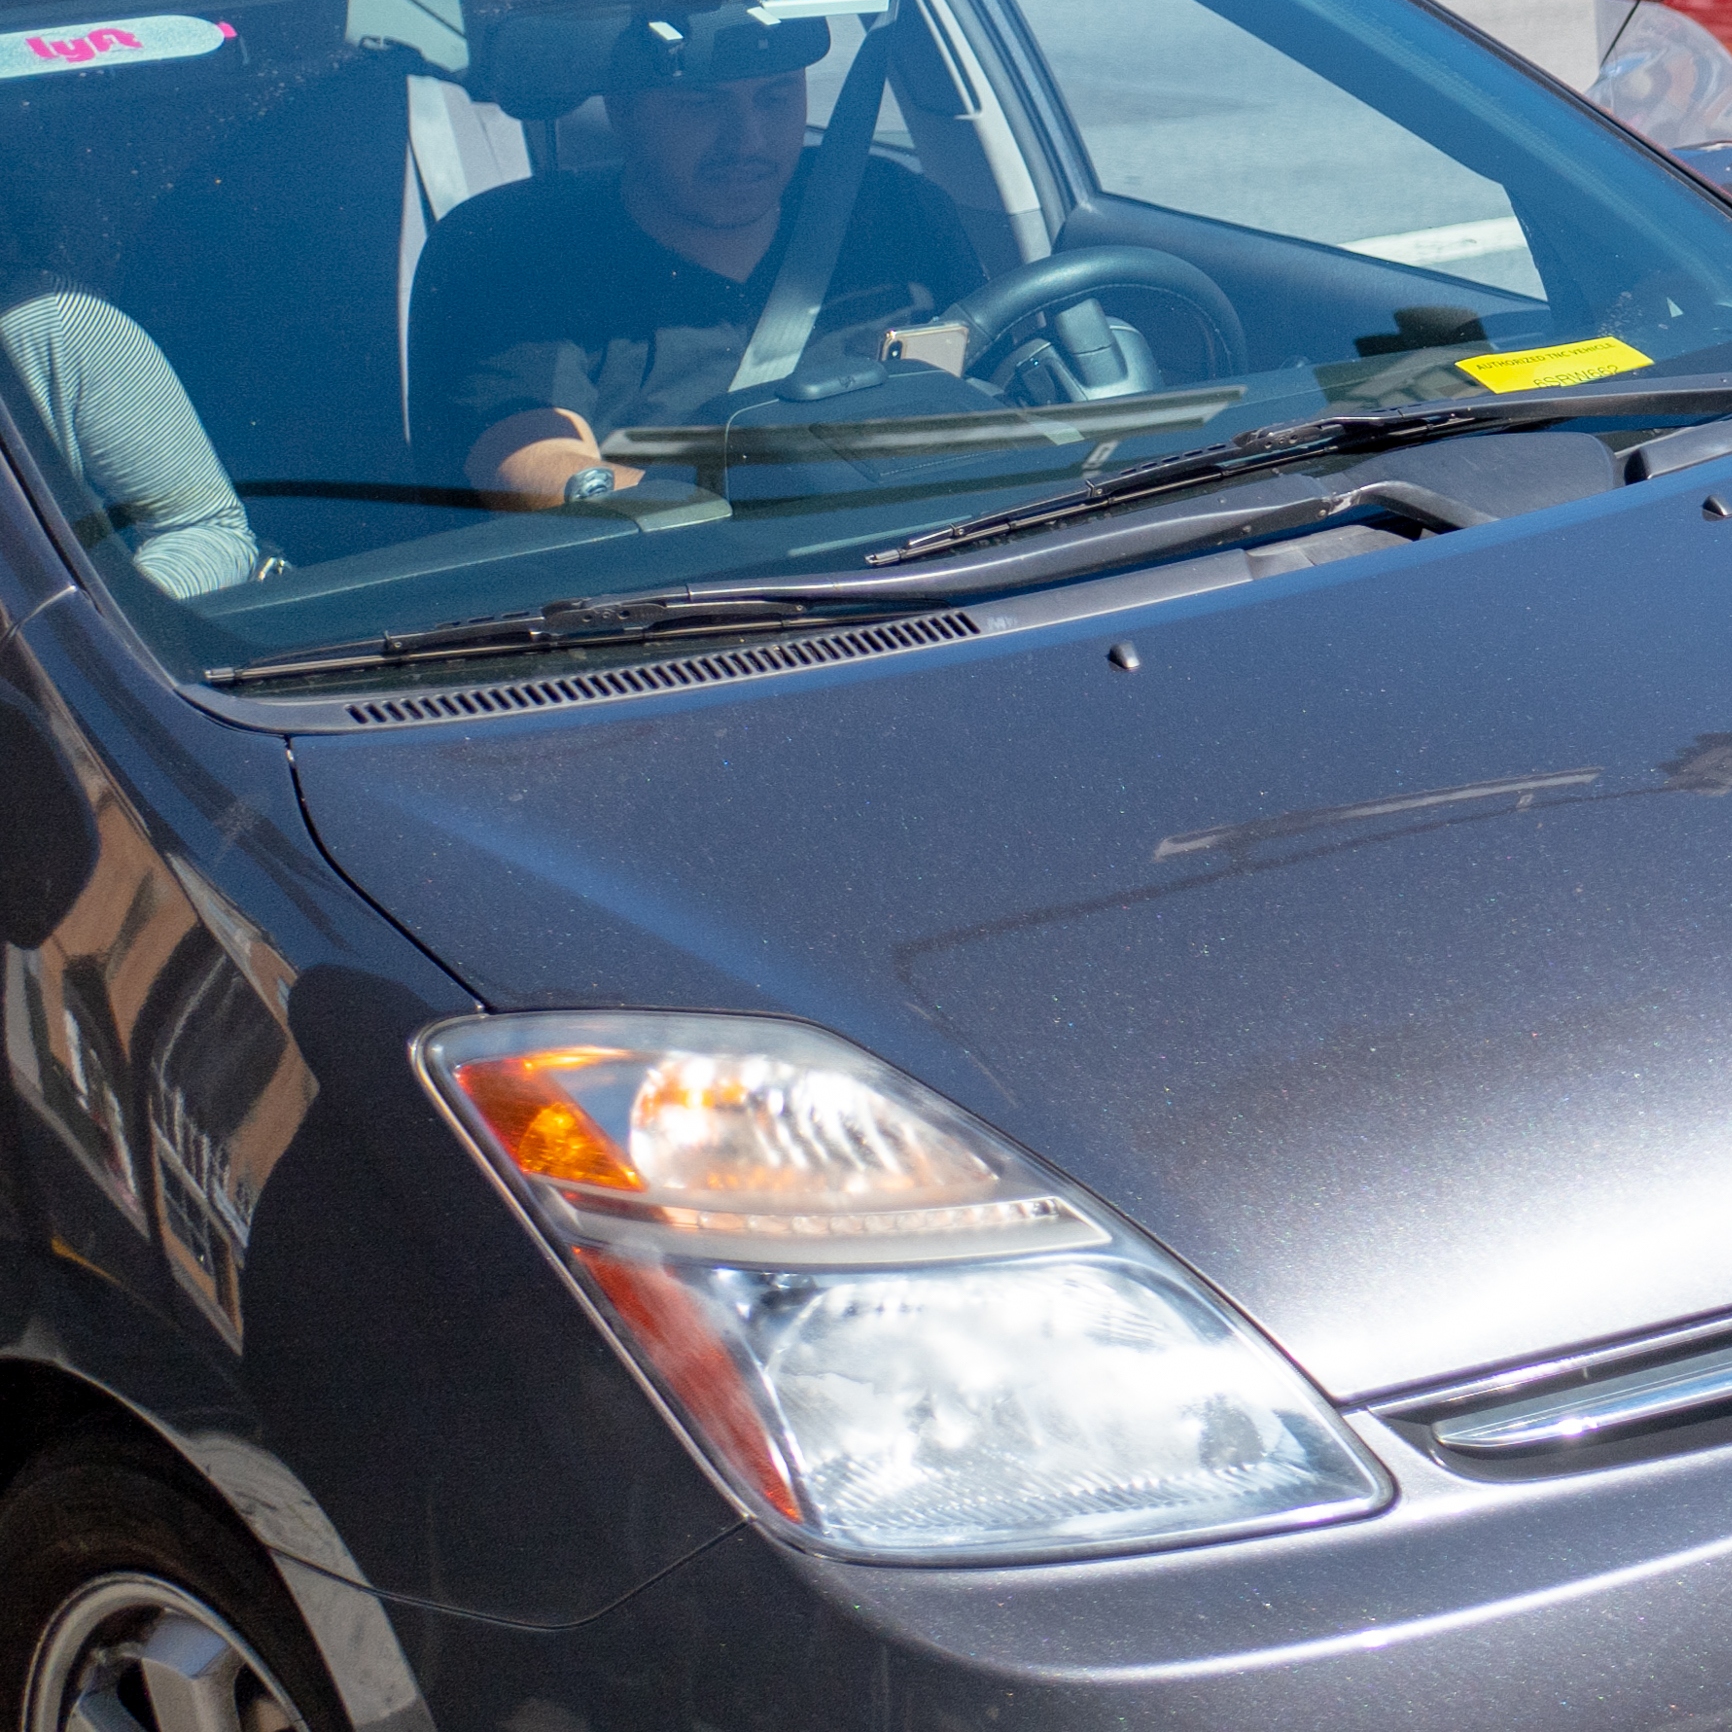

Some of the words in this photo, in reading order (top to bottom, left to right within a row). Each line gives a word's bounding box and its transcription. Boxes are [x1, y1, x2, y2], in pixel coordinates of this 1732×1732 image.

[25, 28, 143, 62] lyft
[1476, 355, 1545, 371] AUTHORIZED
[1546, 351, 1569, 361] TNC
[1572, 342, 1617, 356] VEHICLE
